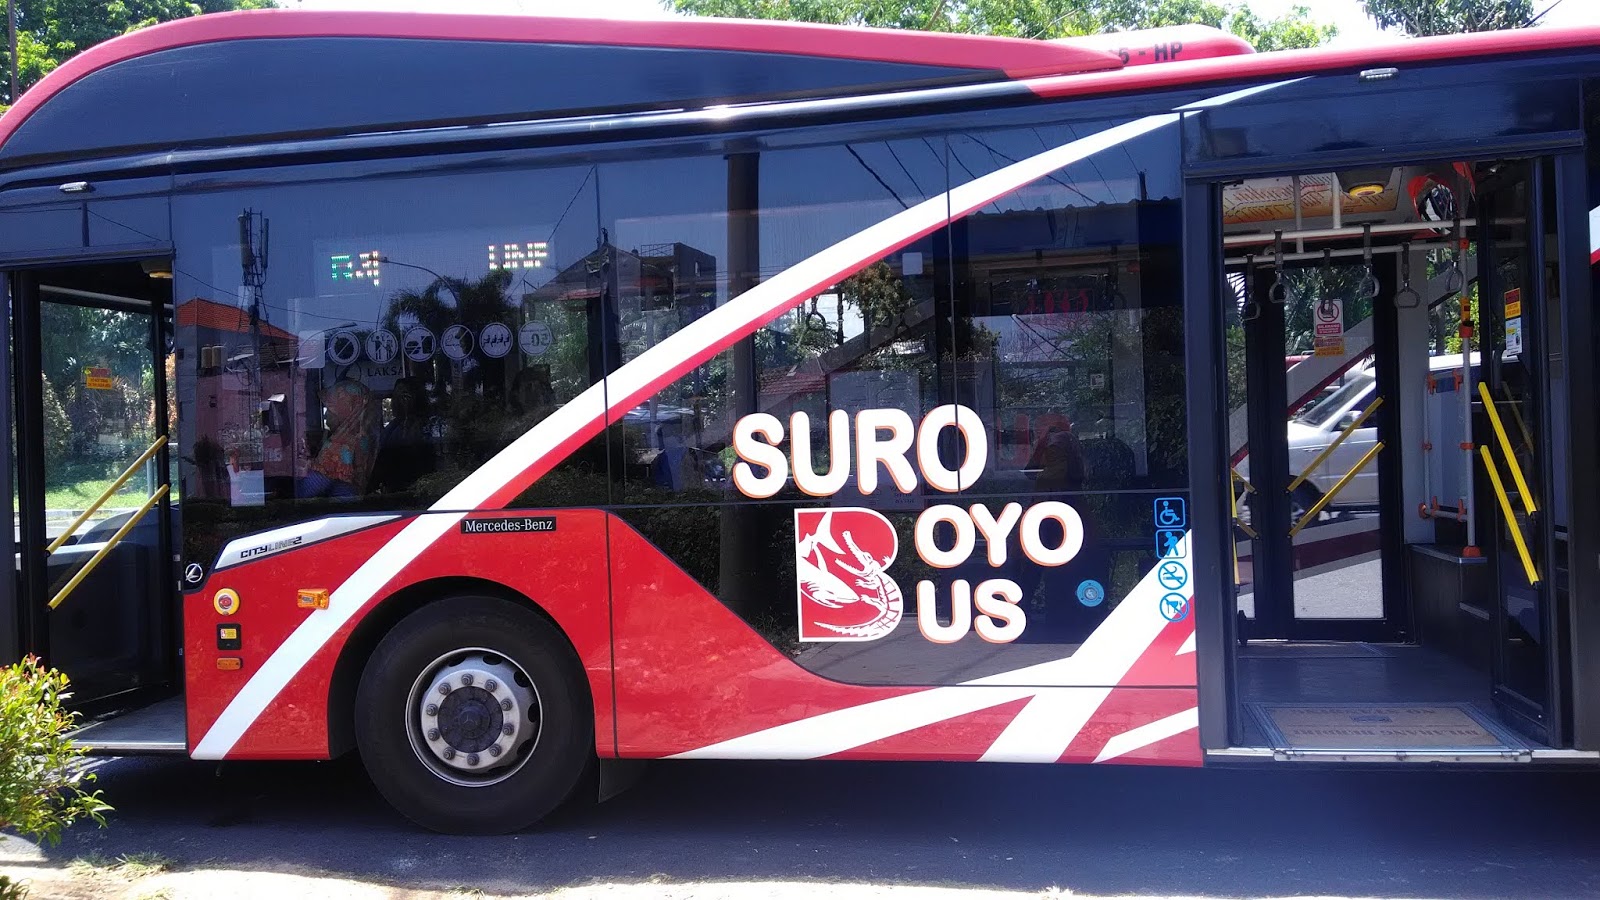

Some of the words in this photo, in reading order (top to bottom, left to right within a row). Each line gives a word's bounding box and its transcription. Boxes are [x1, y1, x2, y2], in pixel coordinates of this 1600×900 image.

[1154, 42, 1183, 61] HP
[733, 404, 988, 498] SURO
[465, 518, 553, 532] Mercedes-Benz
